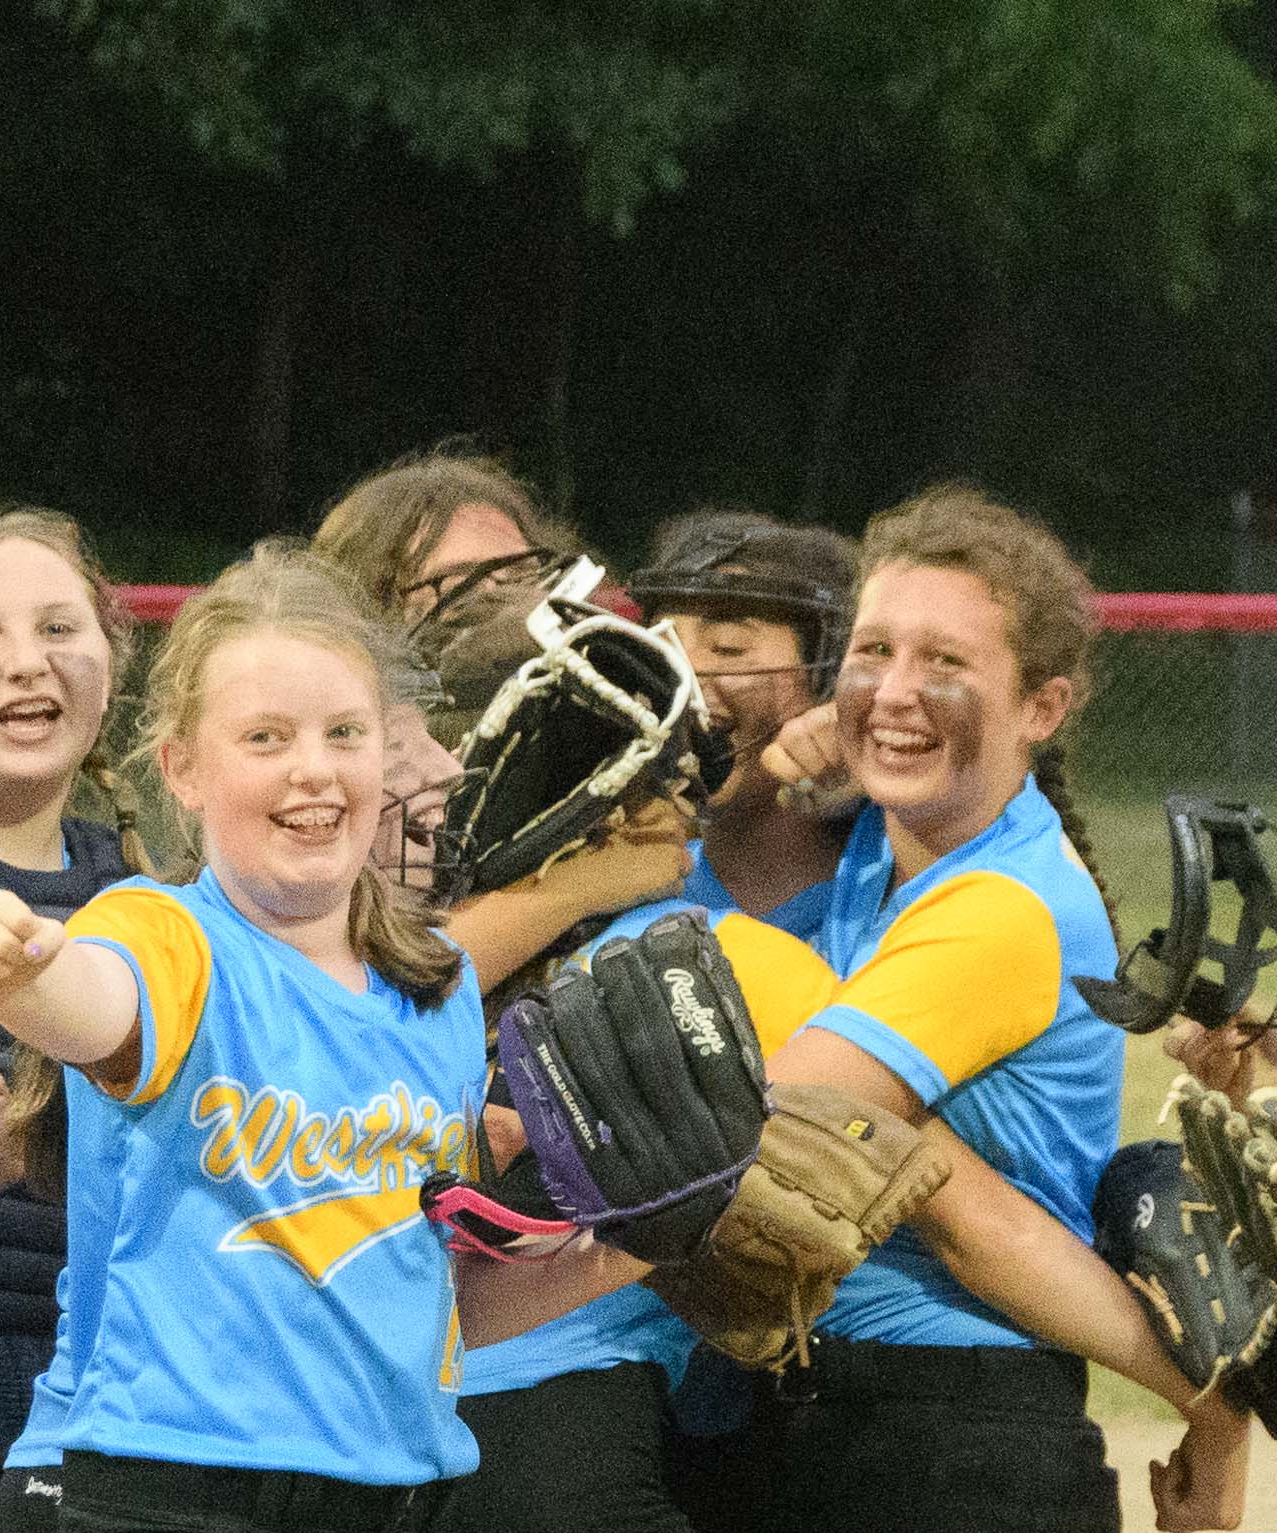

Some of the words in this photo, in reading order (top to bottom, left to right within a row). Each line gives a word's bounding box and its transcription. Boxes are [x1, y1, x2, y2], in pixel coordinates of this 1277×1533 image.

[664, 968, 725, 1054] Rawlings
[537, 1042, 553, 1066] THE
[547, 1064, 567, 1092] GOLD
[562, 1090, 585, 1126] GLOVE
